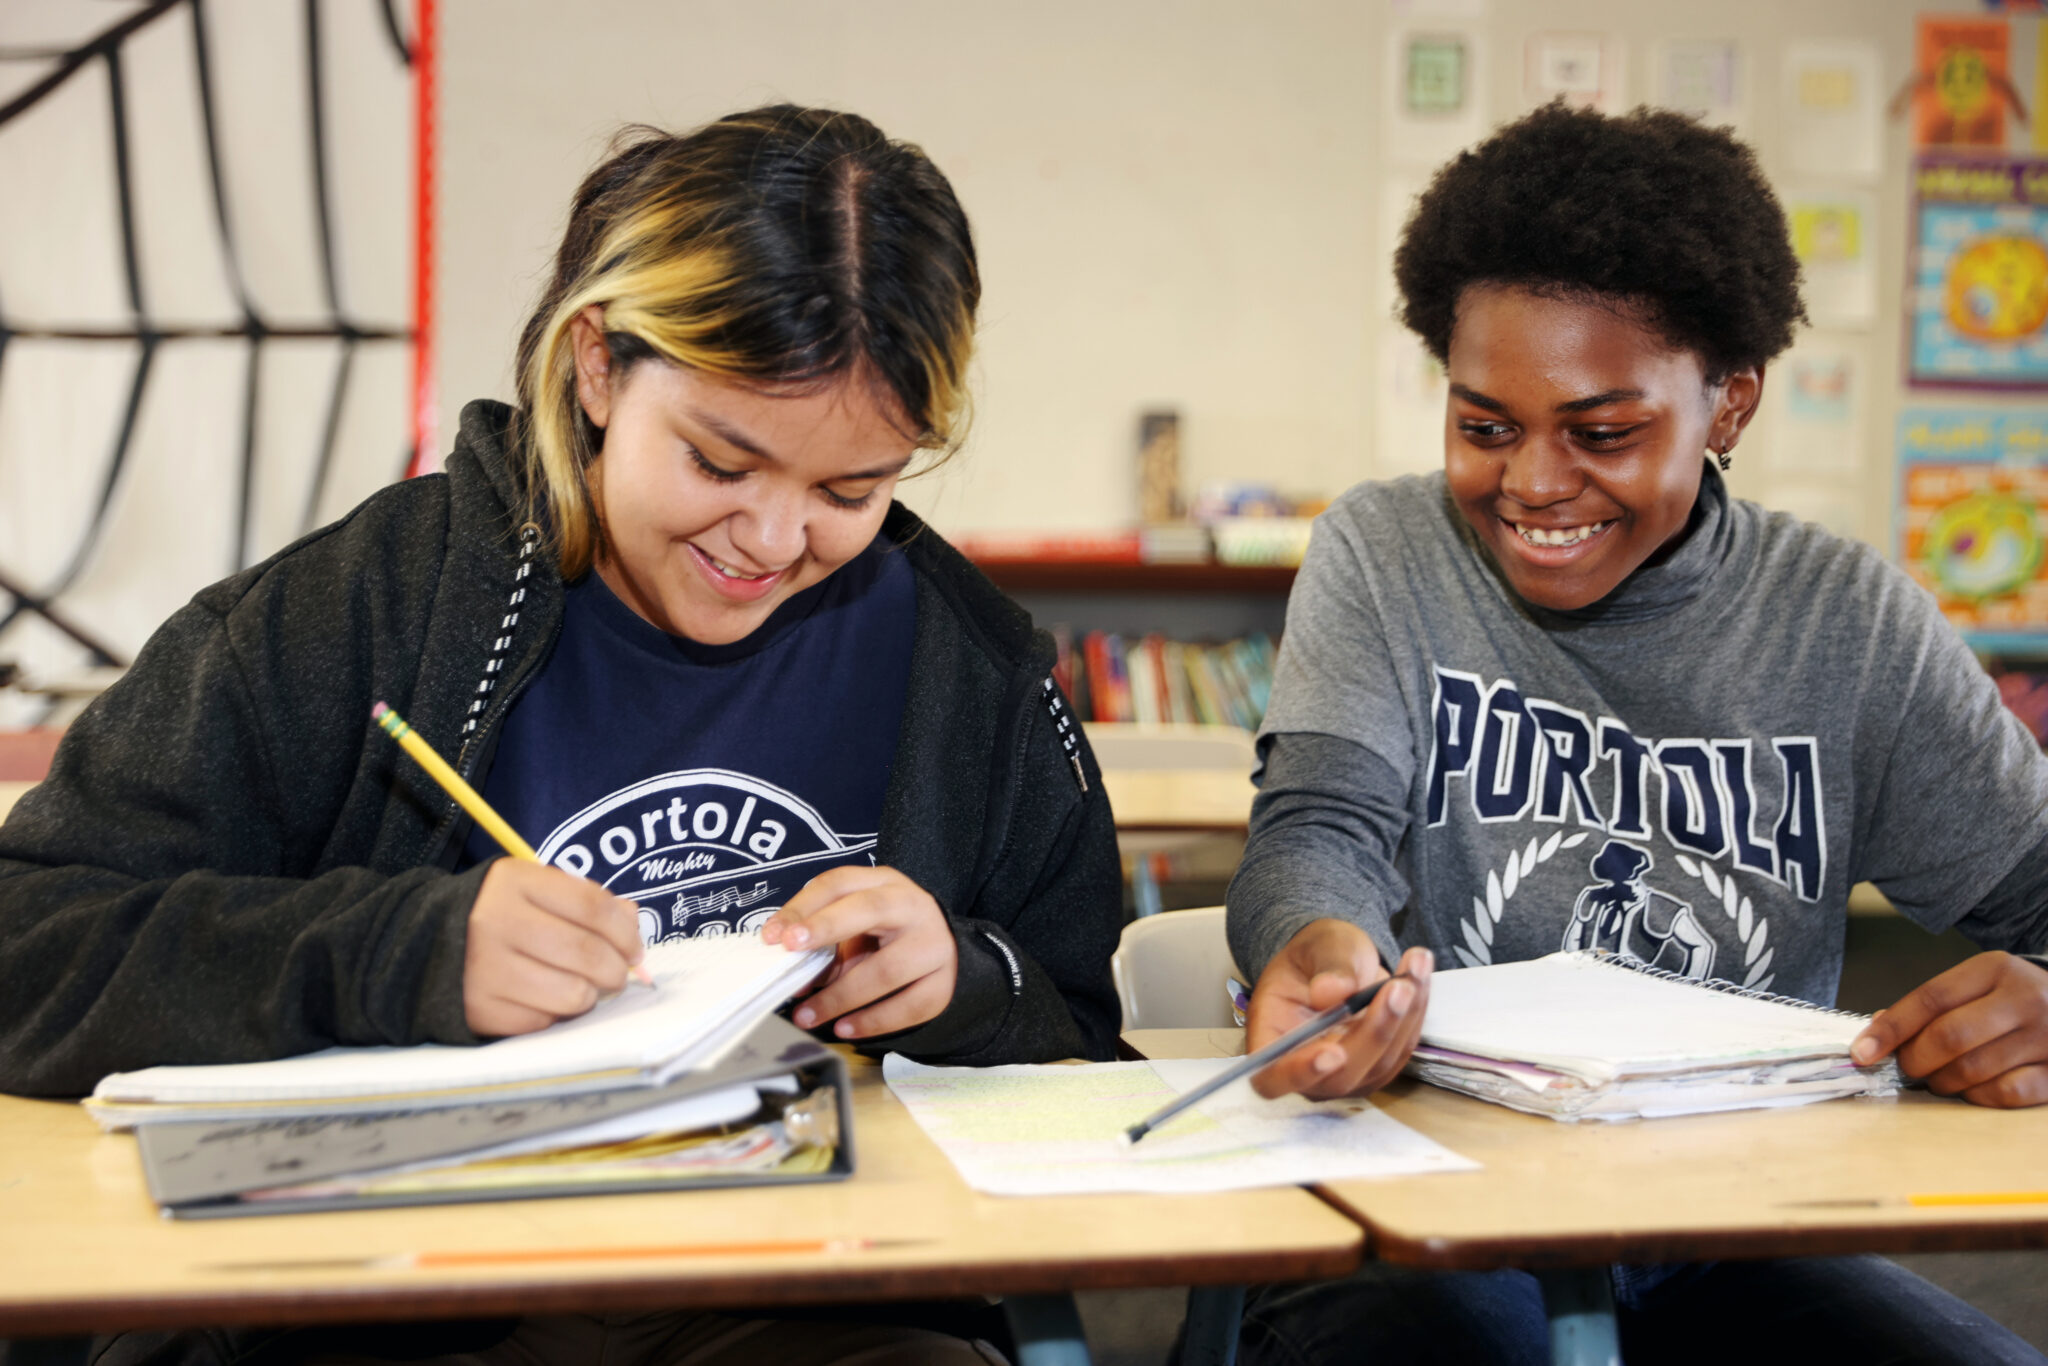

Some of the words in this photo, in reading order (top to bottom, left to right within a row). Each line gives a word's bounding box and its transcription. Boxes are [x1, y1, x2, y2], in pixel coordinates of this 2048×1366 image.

[1427, 664, 1827, 903] PORTOLA
[554, 796, 787, 878] Portola
[638, 851, 716, 882] Mighty
